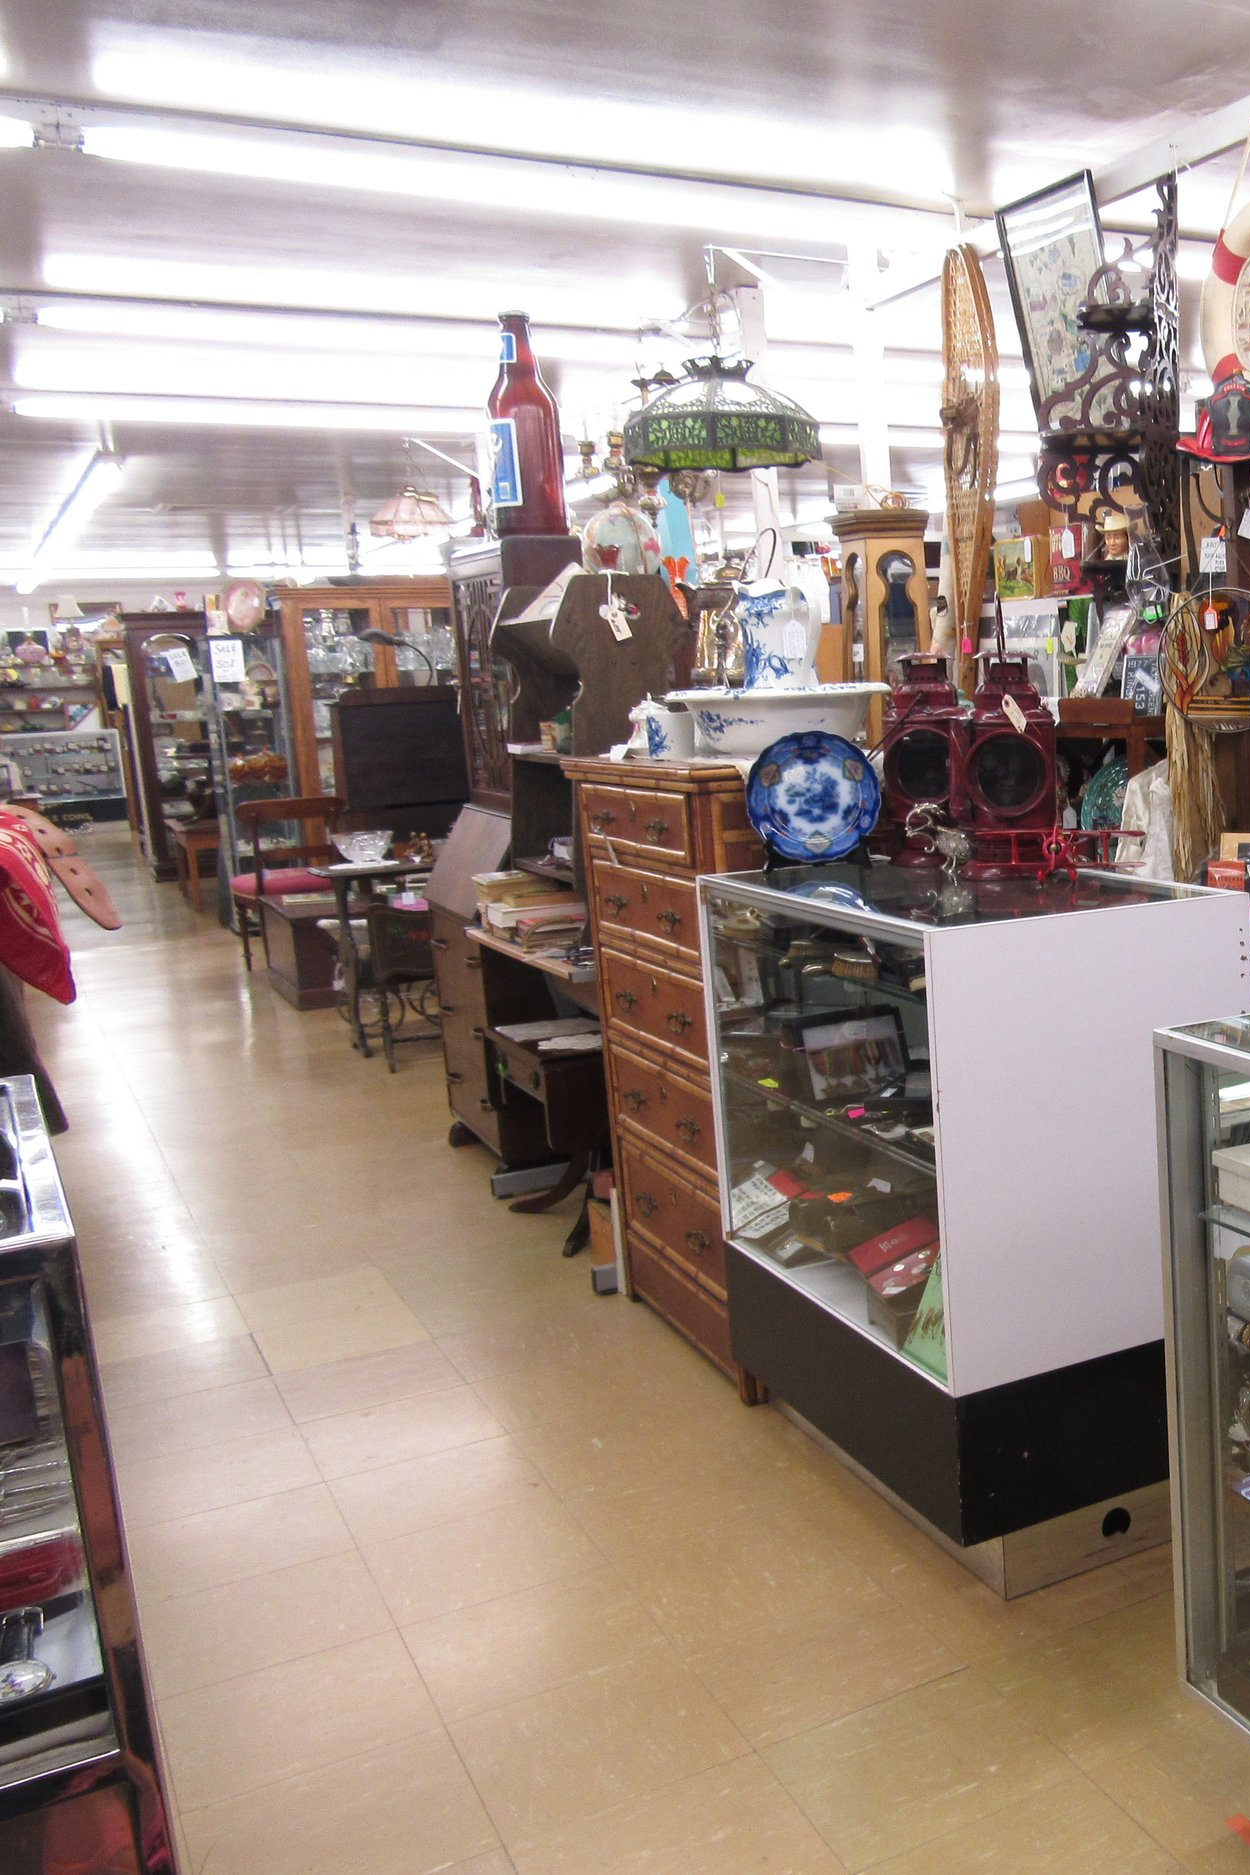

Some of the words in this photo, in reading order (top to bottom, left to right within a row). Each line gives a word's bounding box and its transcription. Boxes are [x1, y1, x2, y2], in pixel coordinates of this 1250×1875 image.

[1053, 565, 1070, 582] BBQ
[215, 643, 237, 653] SALE
[1134, 686, 1146, 710] 153
